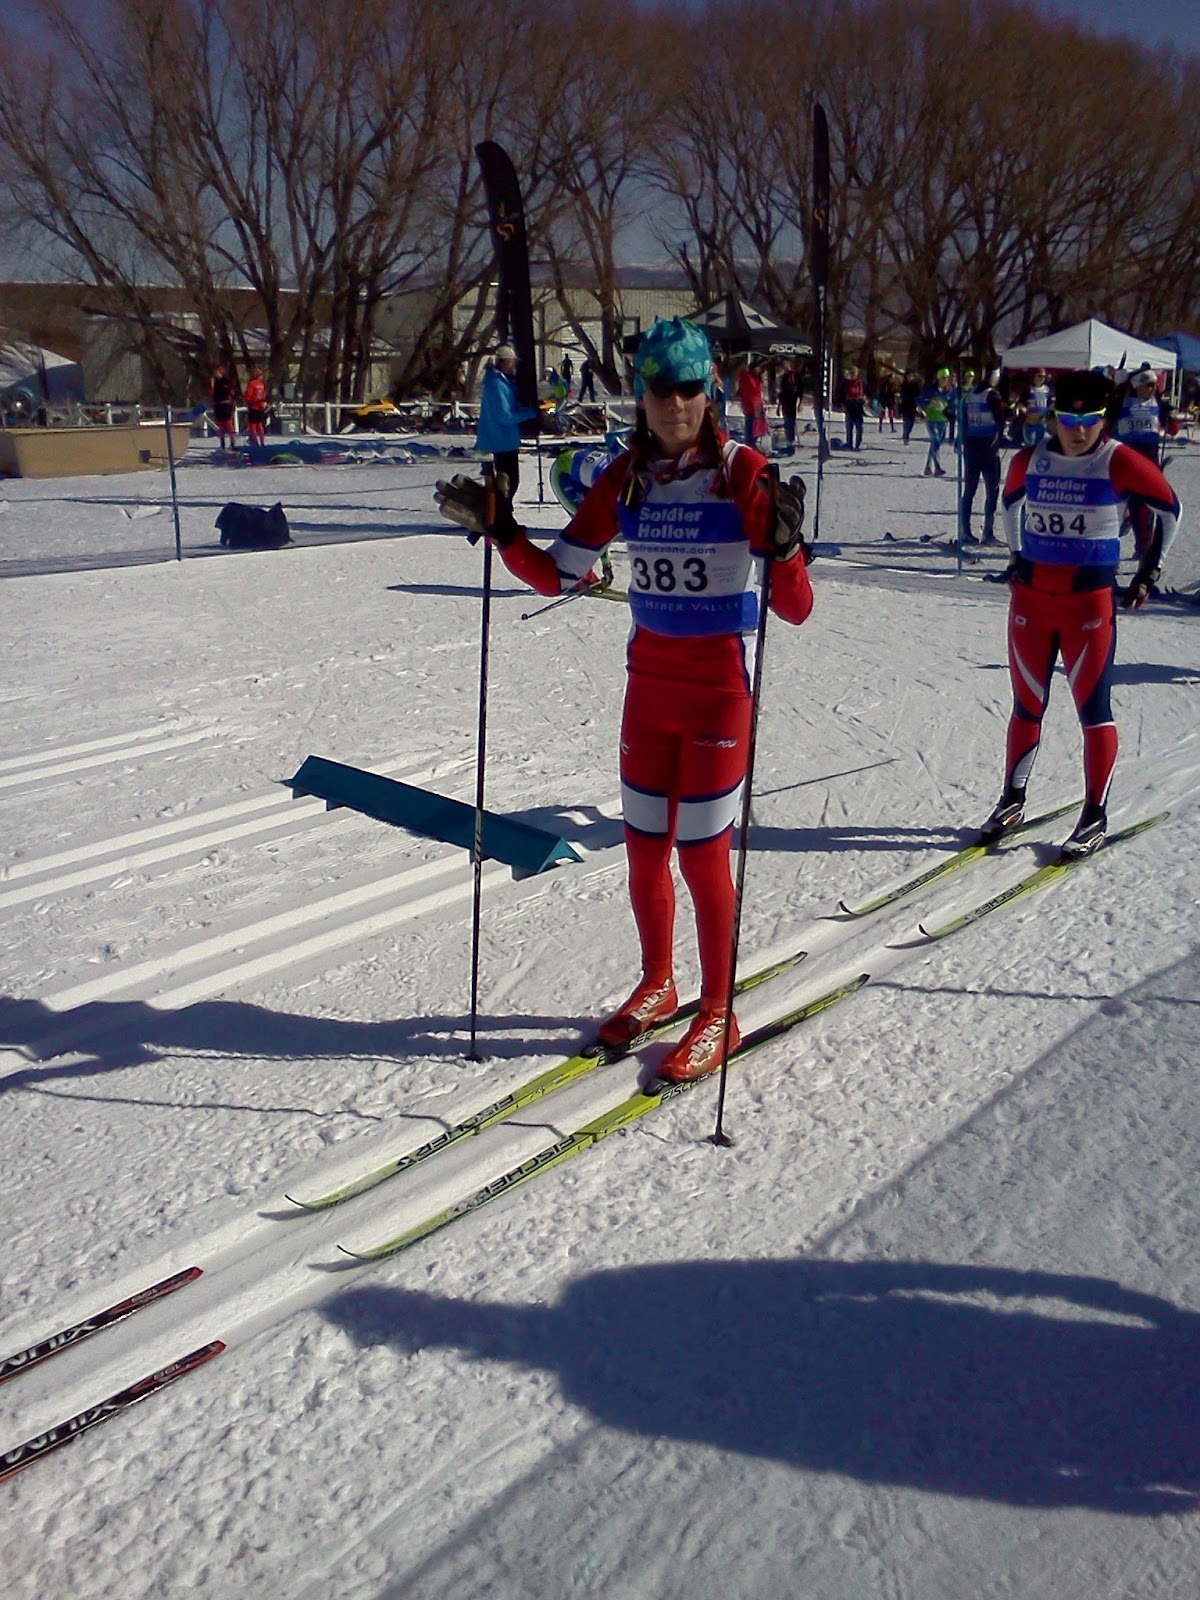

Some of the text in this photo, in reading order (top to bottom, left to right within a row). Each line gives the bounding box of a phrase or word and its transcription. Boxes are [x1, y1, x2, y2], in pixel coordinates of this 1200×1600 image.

[769, 343, 813, 355] FISCHER
[1038, 478, 1088, 492] Soldier
[1036, 489, 1085, 502] Hollow
[639, 506, 704, 523] Soldier
[1031, 512, 1087, 535] 384
[637, 523, 700, 539] Hollow
[633, 557, 708, 592] 383
[974, 883, 1024, 915] FISCHER
[415, 1094, 514, 1157] FISCHER
[474, 1134, 576, 1203] FISCHER
